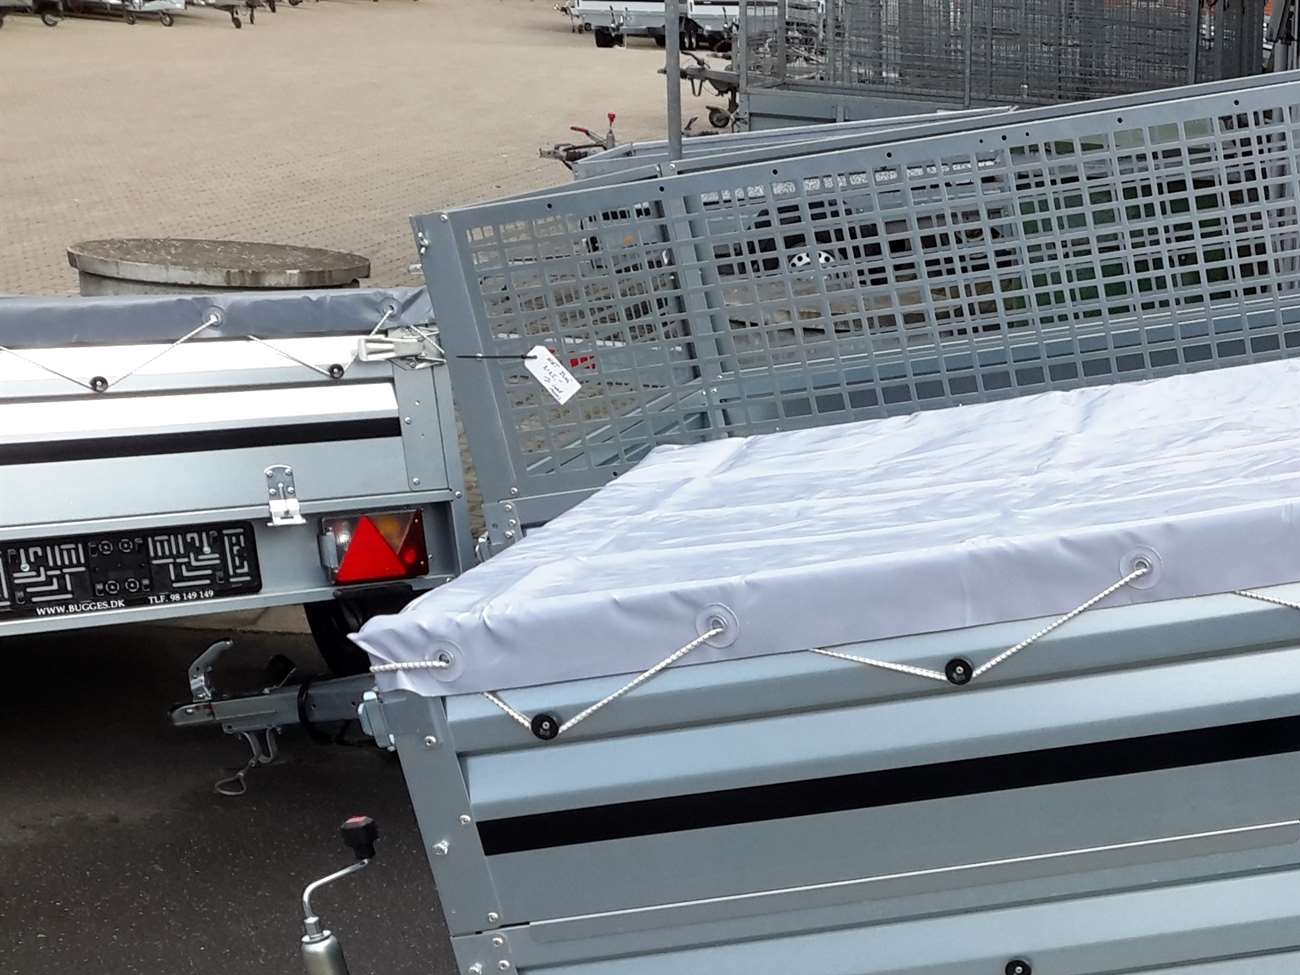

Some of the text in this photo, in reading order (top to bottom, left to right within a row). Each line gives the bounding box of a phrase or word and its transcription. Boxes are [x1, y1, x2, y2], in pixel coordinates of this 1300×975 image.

[148, 589, 214, 605] TLF. 98 149 149
[36, 599, 126, 616] WWW.BUGGES.DK
